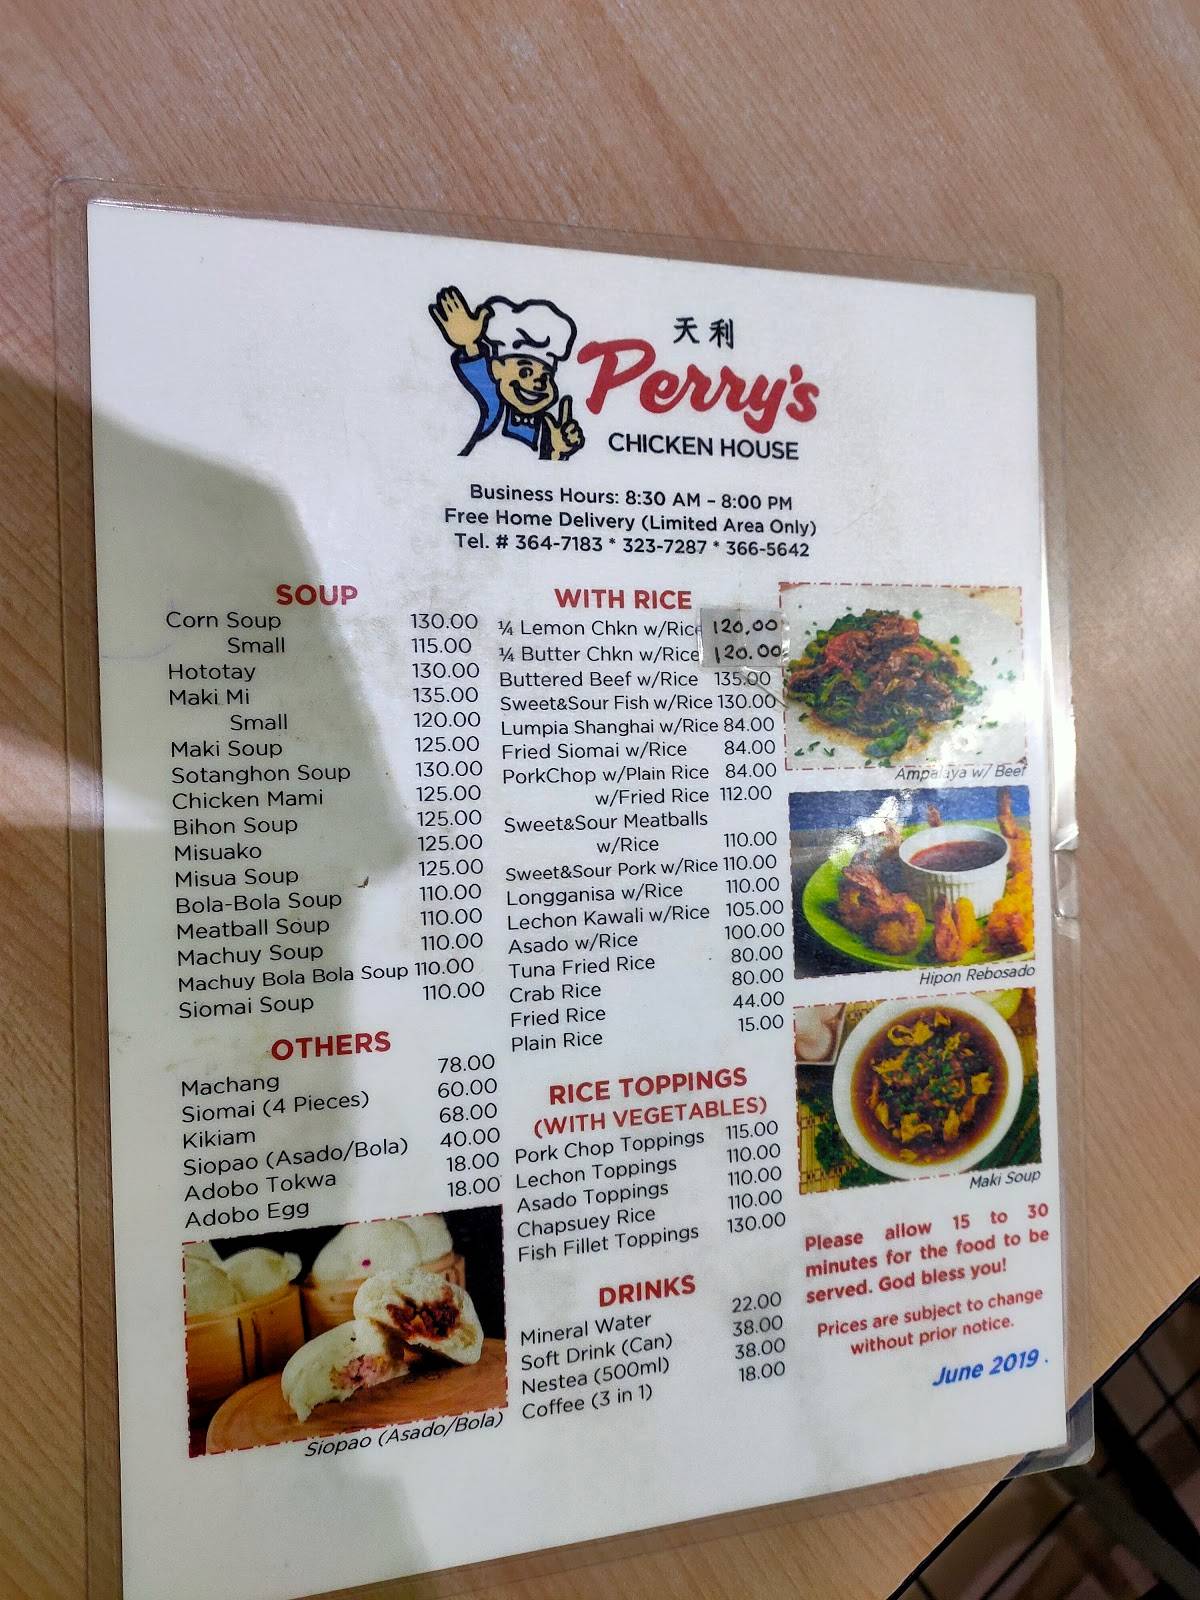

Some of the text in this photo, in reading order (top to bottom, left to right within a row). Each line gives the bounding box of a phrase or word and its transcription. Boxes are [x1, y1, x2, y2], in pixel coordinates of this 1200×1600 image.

[674, 317, 733, 349] 天利
[577, 339, 819, 434] Perry's
[609, 433, 799, 460] CHICKEN HOUSE
[471, 484, 792, 510] Business Hours: 8:30 AM 8:00 PM
[445, 508, 816, 537] Free Home Delivery (Limited Area Only)
[454, 533, 809, 557] Tel. 364-7183 323-7287 366-5642
[276, 584, 358, 606] SOUP
[554, 589, 692, 609] WITH RICE
[166, 612, 478, 631] Corn Soup 130.00
[521, 620, 637, 635] Lemon Chkn
[228, 637, 471, 653] Small 115.00
[522, 646, 699, 663] Butter Chkn w/Rice
[170, 687, 478, 705] Maki Mi 135.00
[501, 694, 776, 711] Sweet&Sour Fish w/Rice 130.00
[502, 717, 774, 737] Lumpia Shanghai w/Rice 84.00
[172, 761, 482, 785] Sotanghon Soup 130.00
[504, 763, 776, 785] PorkChop w/Plain Rice 84.00
[173, 785, 481, 809] Chicken Mami 125.00
[505, 811, 707, 833] Sweet&Sour Meatballs
[176, 859, 483, 887] Misua Soup 125.00
[177, 884, 481, 913] Bola-Bola Soup 110.00
[507, 877, 779, 906] Longganisa w/Rice 110.00
[178, 933, 483, 966] Machuy Soup 110.00
[509, 946, 782, 978] Tuna Fried Rice 80.00
[179, 958, 474, 992] Machuy Bola Bola Soup 110.00
[920, 965, 1035, 986] Hipon Rebosado
[511, 991, 784, 1027] Fried Rice 44.00
[271, 1030, 391, 1060] OTHERS
[182, 1054, 495, 1096] Machang 78.00
[550, 1067, 747, 1105] RICE TOPPINGS
[182, 1101, 254, 1122] Siomai
[295, 1091, 368, 1112] Pieces)
[438, 1078, 497, 1098] 60.00
[534, 1097, 766, 1139] (WITH VEGETABLES)
[184, 1128, 500, 1176] Siopao (Asado/Bola) 40.00
[516, 1121, 778, 1164] Pork Chop Toppings 115.00
[185, 1152, 499, 1201] Adobo Tokwa 18.00
[517, 1143, 780, 1188] Lechon Toppings 110.00
[970, 1171, 1040, 1189] Maki Soup
[185, 1177, 500, 1228] Adobo Egg 18.00
[518, 1189, 782, 1237] Chapsuey Rice 110.00
[806, 1203, 1048, 1251] Please allow 15 to 30
[806, 1229, 1049, 1277] minutes for the food to be
[600, 1275, 695, 1307] DRINKS
[807, 1258, 1006, 1304] served. God bless you!
[521, 1292, 781, 1346] Mineral Water 22.00
[818, 1290, 1043, 1337] Prices are subject to change
[851, 1317, 1013, 1355] without prior notice.
[523, 1338, 785, 1394] Nestea (500ml) 38.00
[932, 1349, 1039, 1386] June 2019
[305, 1412, 504, 1456] Siopao (Asado/Bola)
